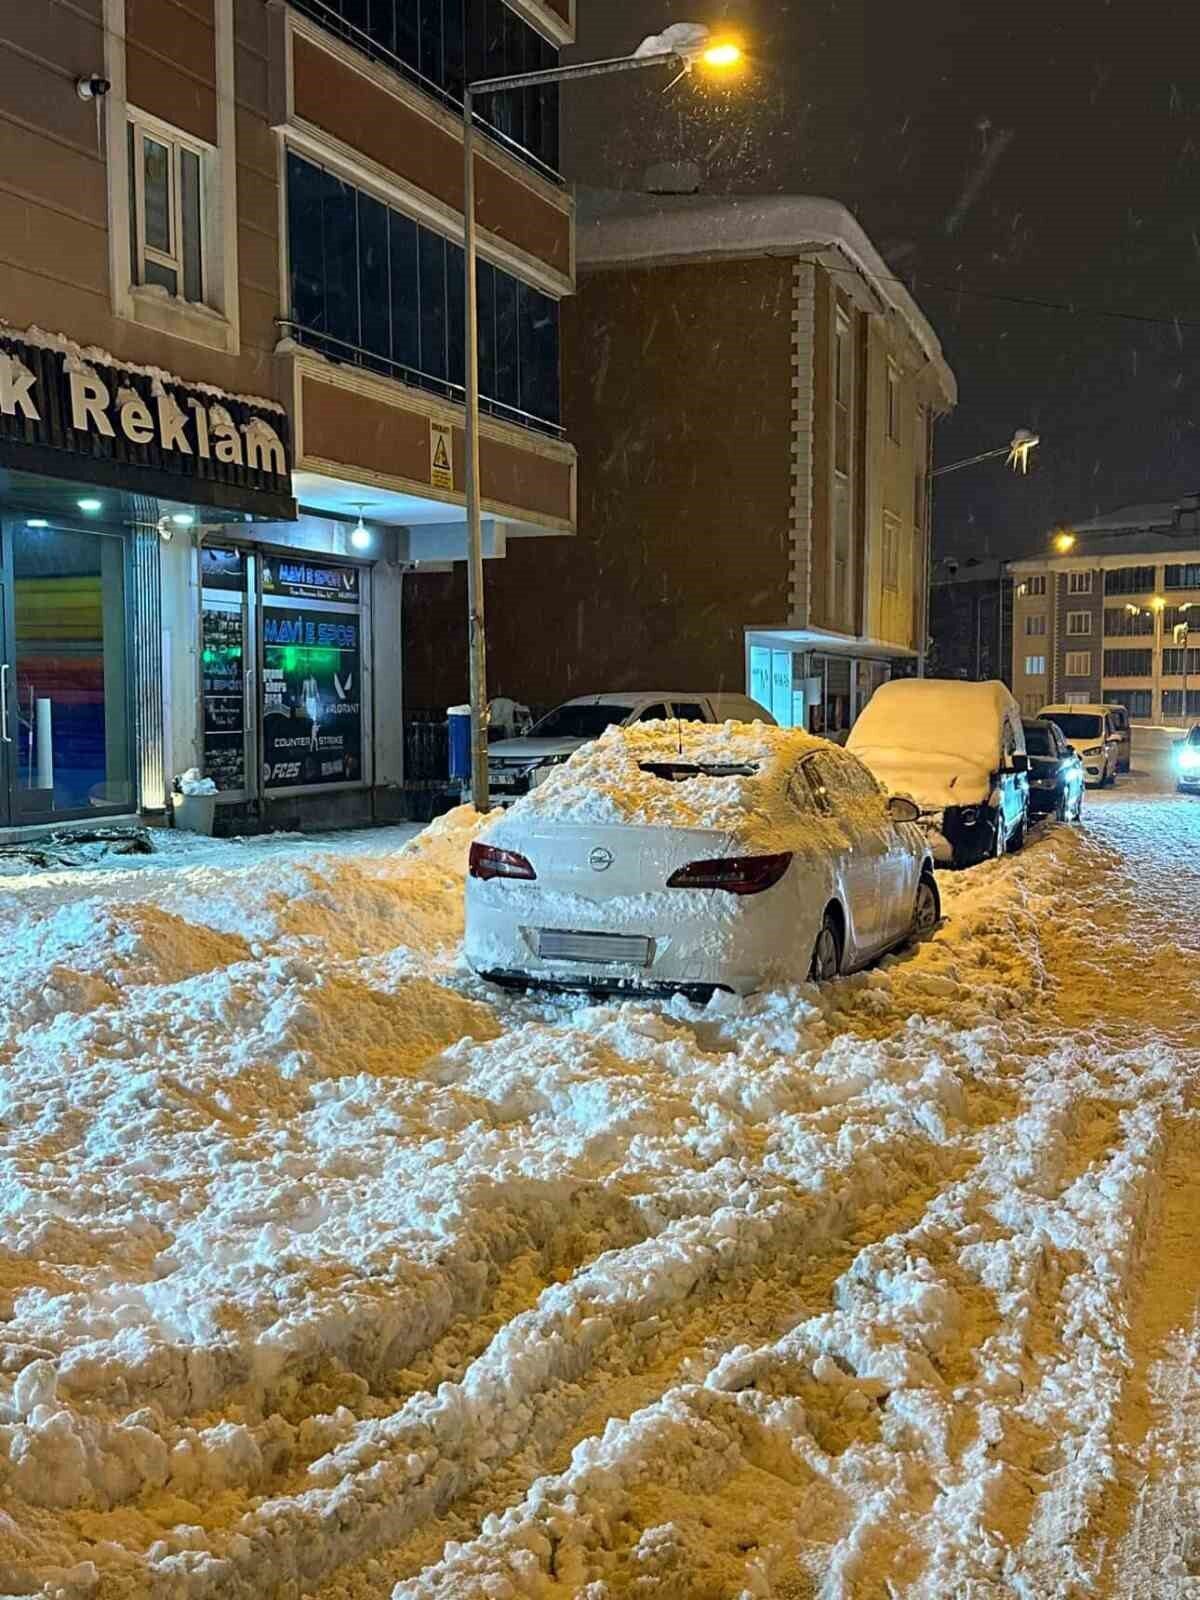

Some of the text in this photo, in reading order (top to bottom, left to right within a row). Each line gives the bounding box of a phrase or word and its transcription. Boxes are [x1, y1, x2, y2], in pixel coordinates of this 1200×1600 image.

[68, 366, 287, 476] Reklam
[274, 735, 344, 748] COUNTER STRIKE
